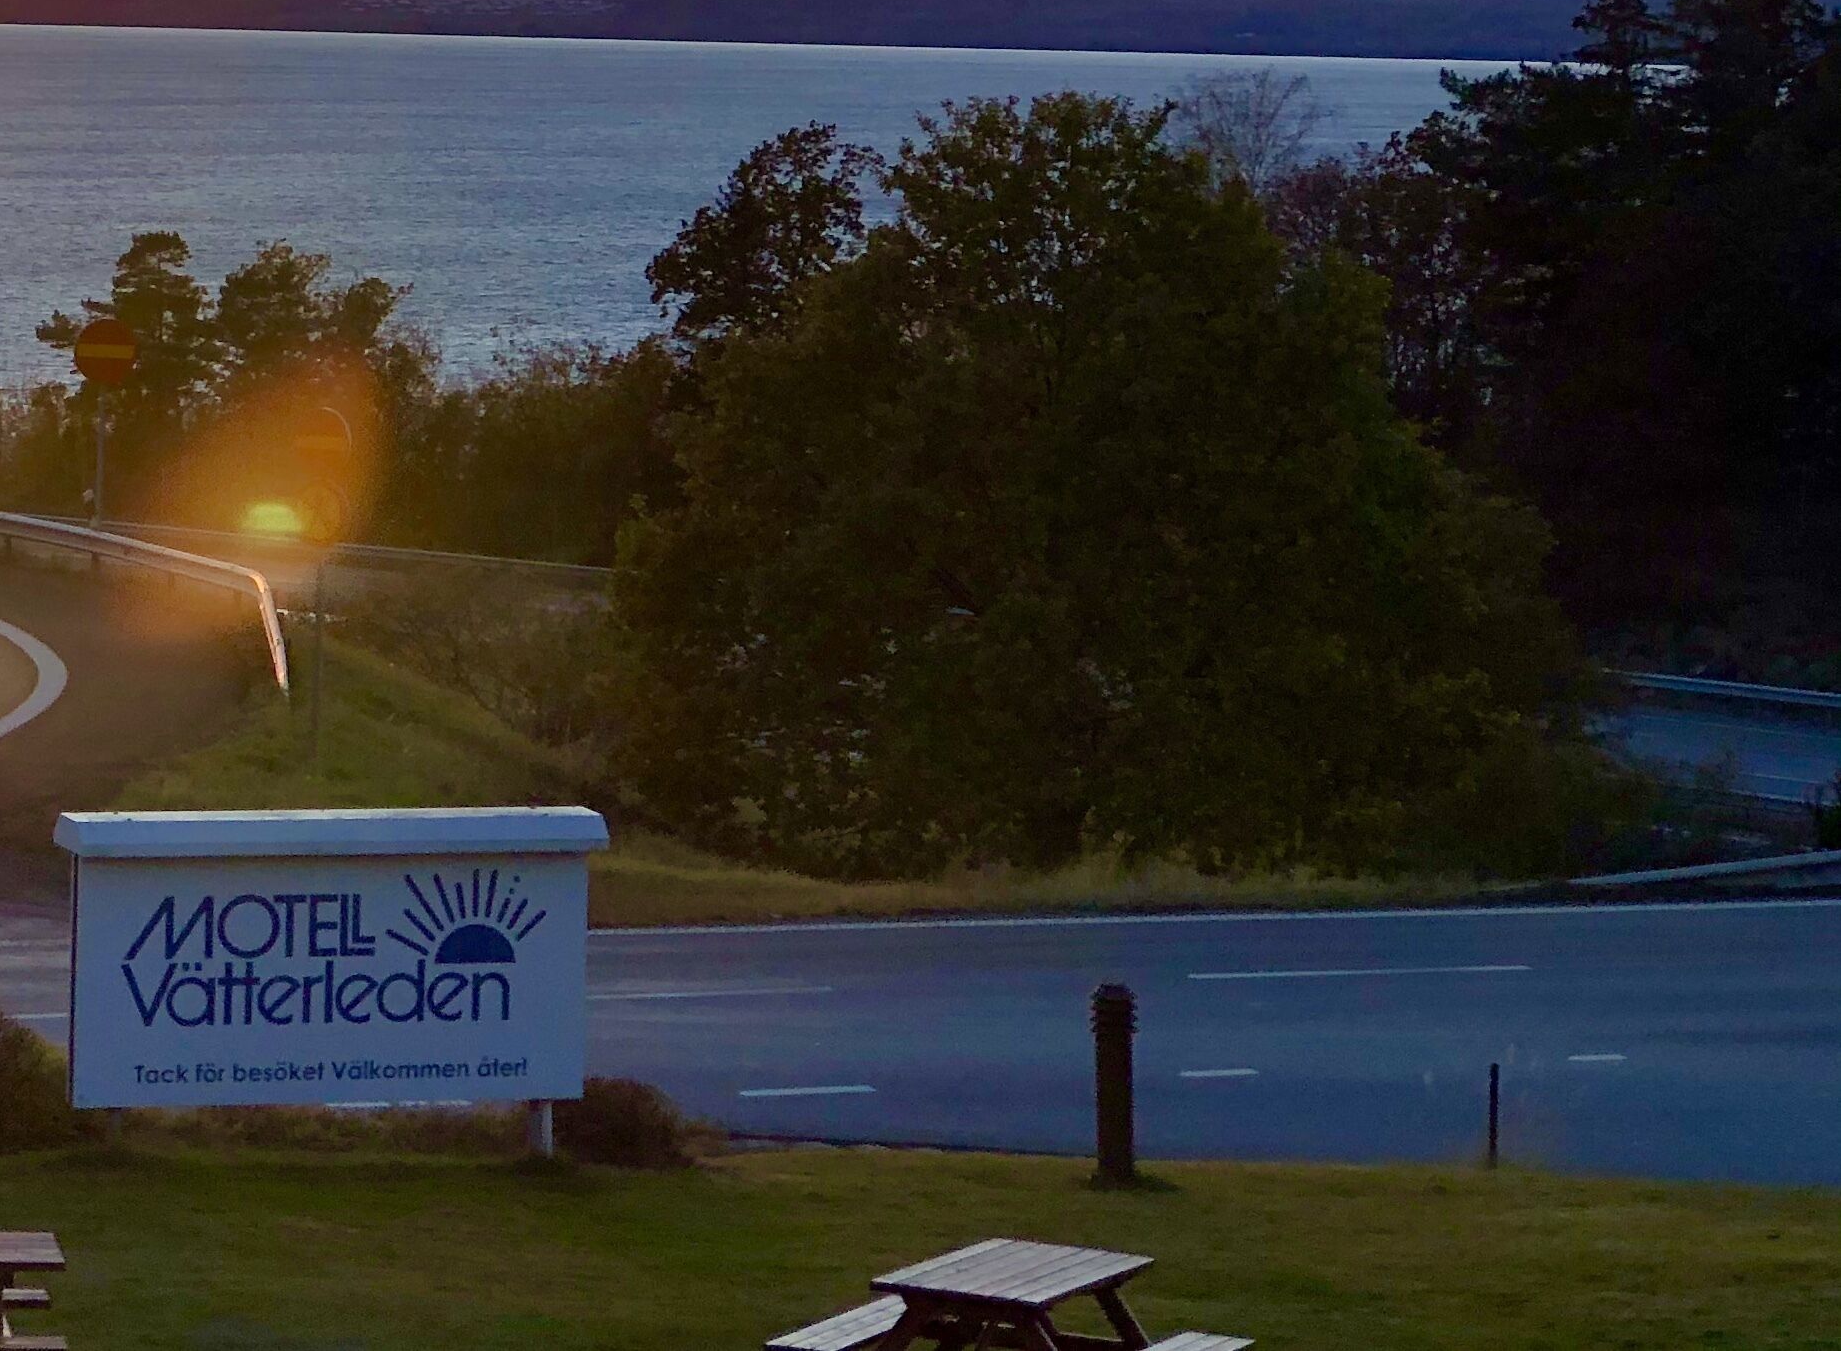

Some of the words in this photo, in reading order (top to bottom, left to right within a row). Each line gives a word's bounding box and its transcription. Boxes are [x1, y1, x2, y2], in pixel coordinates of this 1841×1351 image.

[124, 893, 376, 961] MOTELL
[120, 959, 510, 1028] Vätterleden
[133, 1064, 190, 1084] Tack
[195, 1062, 226, 1083] för
[232, 1059, 325, 1083] besöket
[331, 1058, 471, 1081] Välkommen
[477, 1055, 528, 1078] åter!
